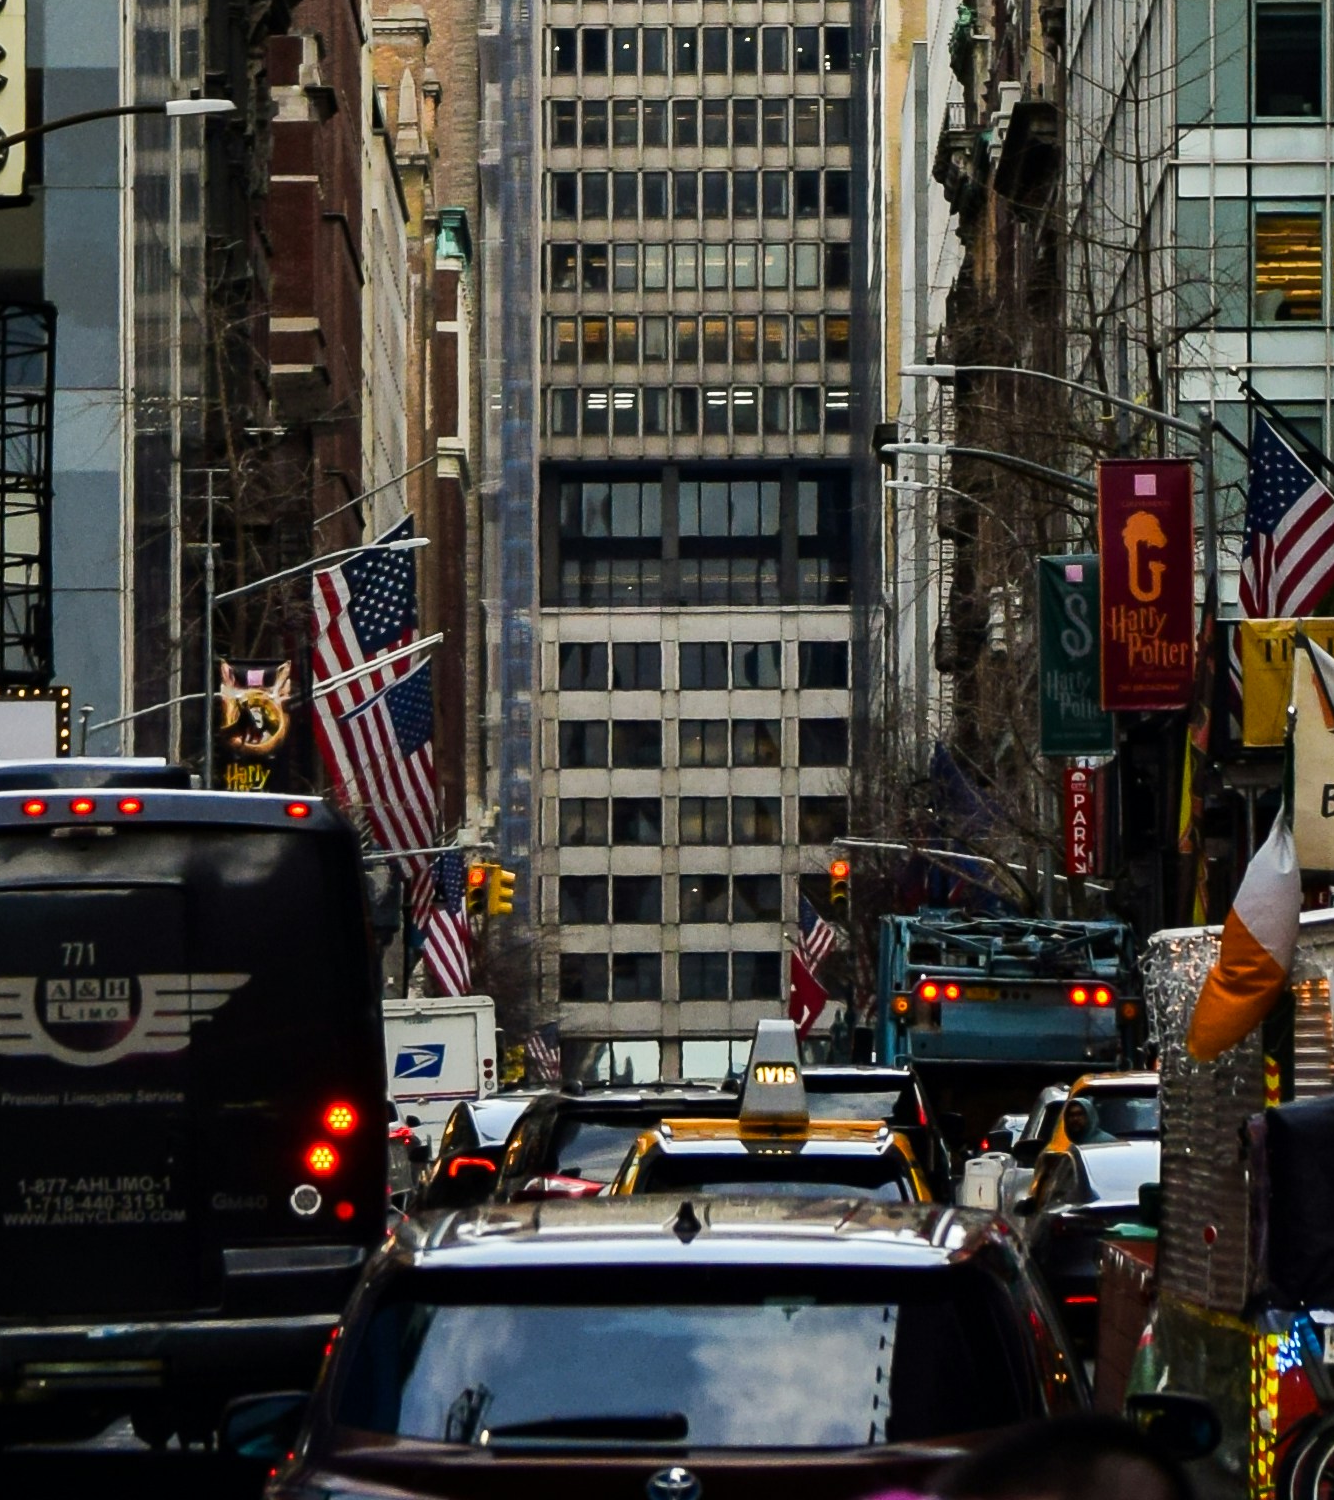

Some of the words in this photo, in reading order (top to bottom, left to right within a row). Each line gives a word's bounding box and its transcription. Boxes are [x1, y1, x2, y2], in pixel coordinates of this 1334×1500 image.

[1107, 604, 1167, 647] Harry
[1126, 638, 1189, 674] Potter
[1073, 793, 1087, 858] PARK
[61, 942, 96, 966] 771
[755, 1066, 796, 1084] 1V15
[1, 1092, 59, 1107] Premium
[136, 1090, 185, 1103] Service
[18, 1176, 172, 1195] 1-877-AHLIMO-1
